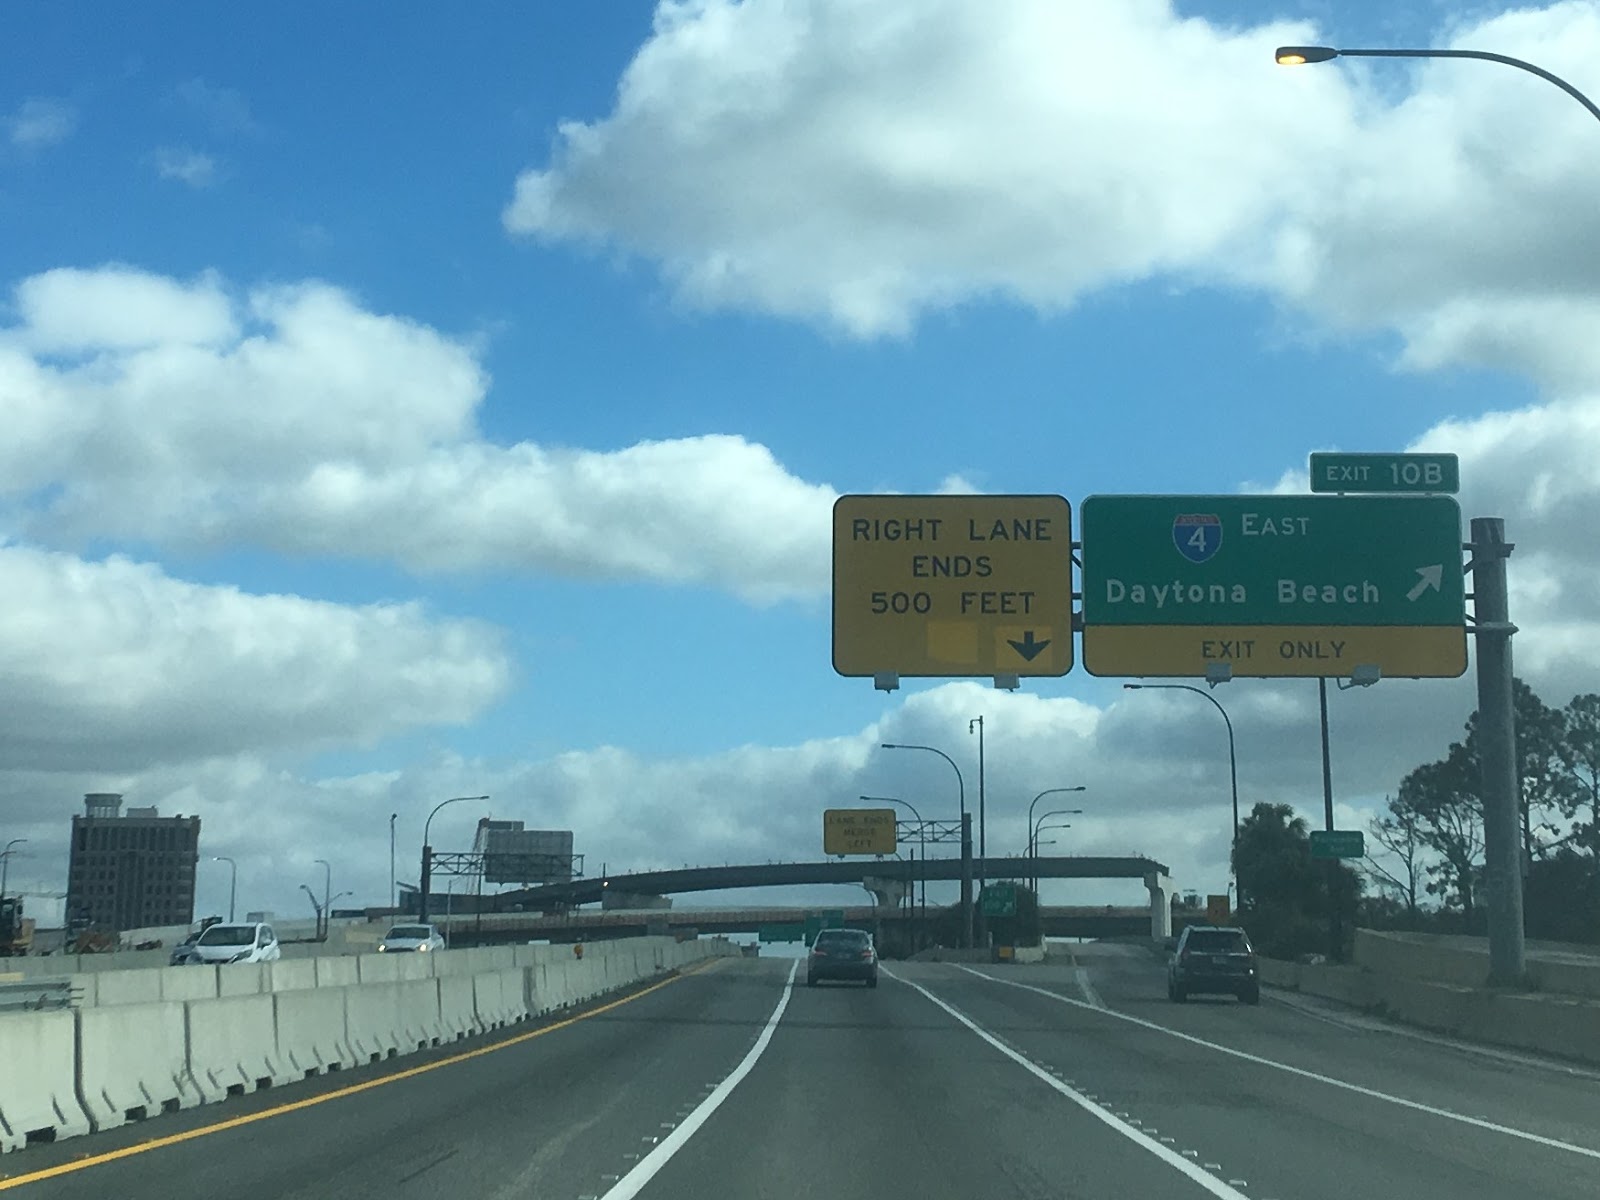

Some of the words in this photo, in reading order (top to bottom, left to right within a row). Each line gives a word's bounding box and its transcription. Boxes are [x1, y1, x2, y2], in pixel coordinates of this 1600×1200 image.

[1326, 465, 1371, 481] EXIT
[1390, 462, 1443, 484] 10B
[852, 518, 943, 541] RIGHT
[969, 518, 1052, 541] LANE
[1241, 513, 1310, 535] EAST
[1187, 526, 1207, 552] 4
[912, 555, 993, 578] ENDS
[871, 591, 932, 614] 500
[960, 591, 1036, 614] FEET
[1106, 578, 1247, 609] Daytona
[1277, 579, 1380, 603] Beach
[1202, 640, 1255, 659] EXIT
[1279, 640, 1346, 659] ONLY
